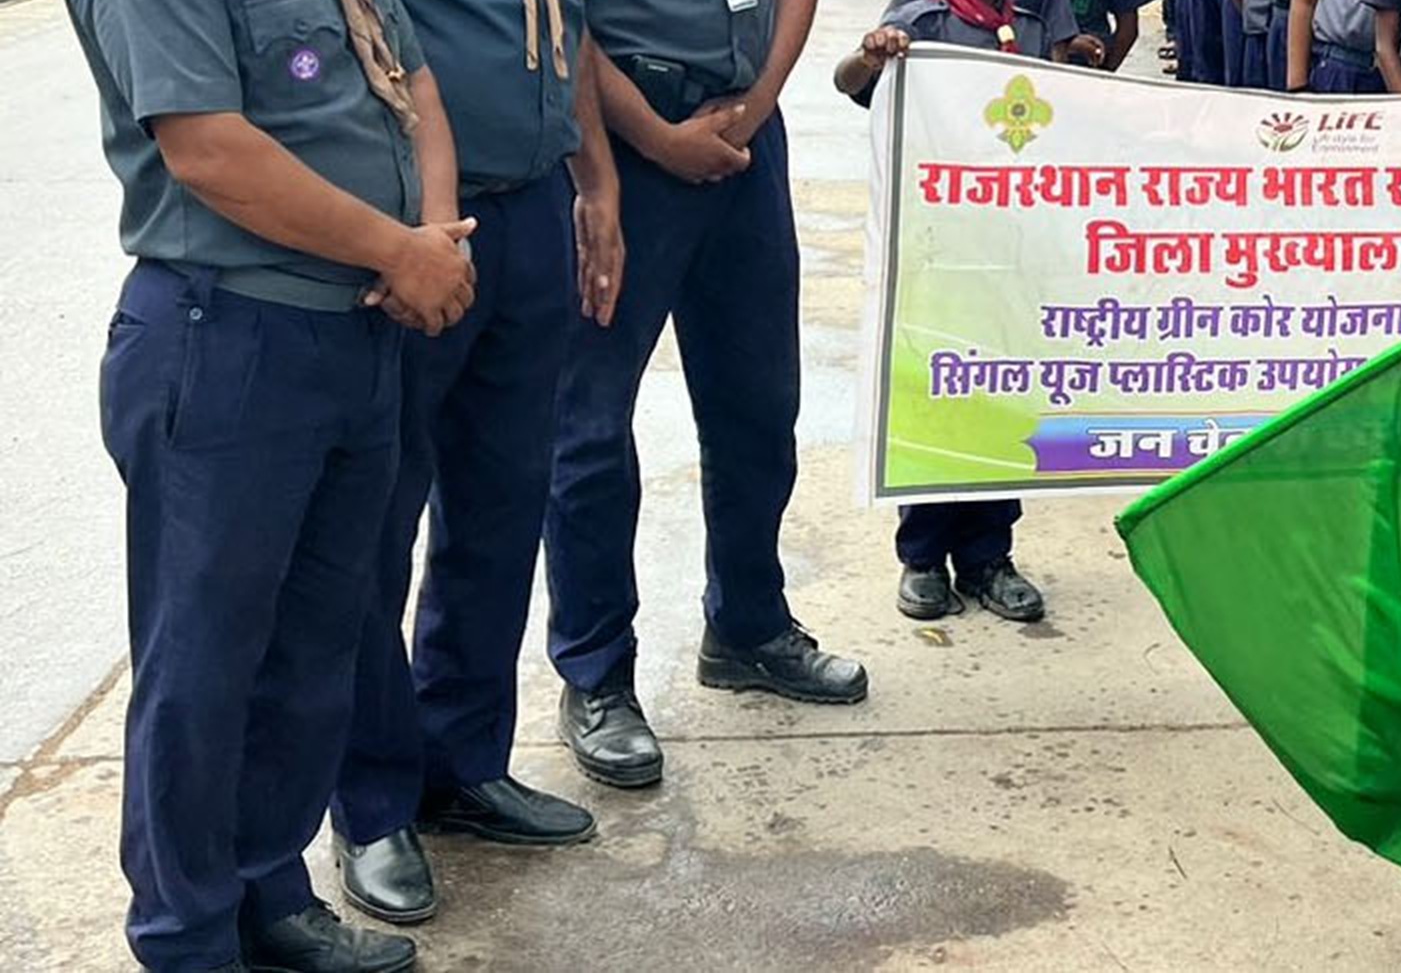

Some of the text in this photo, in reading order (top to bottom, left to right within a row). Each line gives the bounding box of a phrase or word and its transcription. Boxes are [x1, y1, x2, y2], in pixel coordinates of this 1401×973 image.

[918, 163, 1131, 208] राजस्थान
[1140, 167, 1253, 207] राज्य
[1263, 167, 1378, 207] भारत
[1086, 219, 1215, 275] जिला
[1040, 296, 1151, 347] राष्ट्रीय
[1156, 296, 1223, 341] ग्रीन
[1230, 294, 1295, 339] कोर
[931, 348, 1034, 396] सिंगल
[1039, 360, 1102, 405] यूज
[1109, 352, 1251, 394] प्लास्टिक
[1088, 426, 1178, 458] जन
